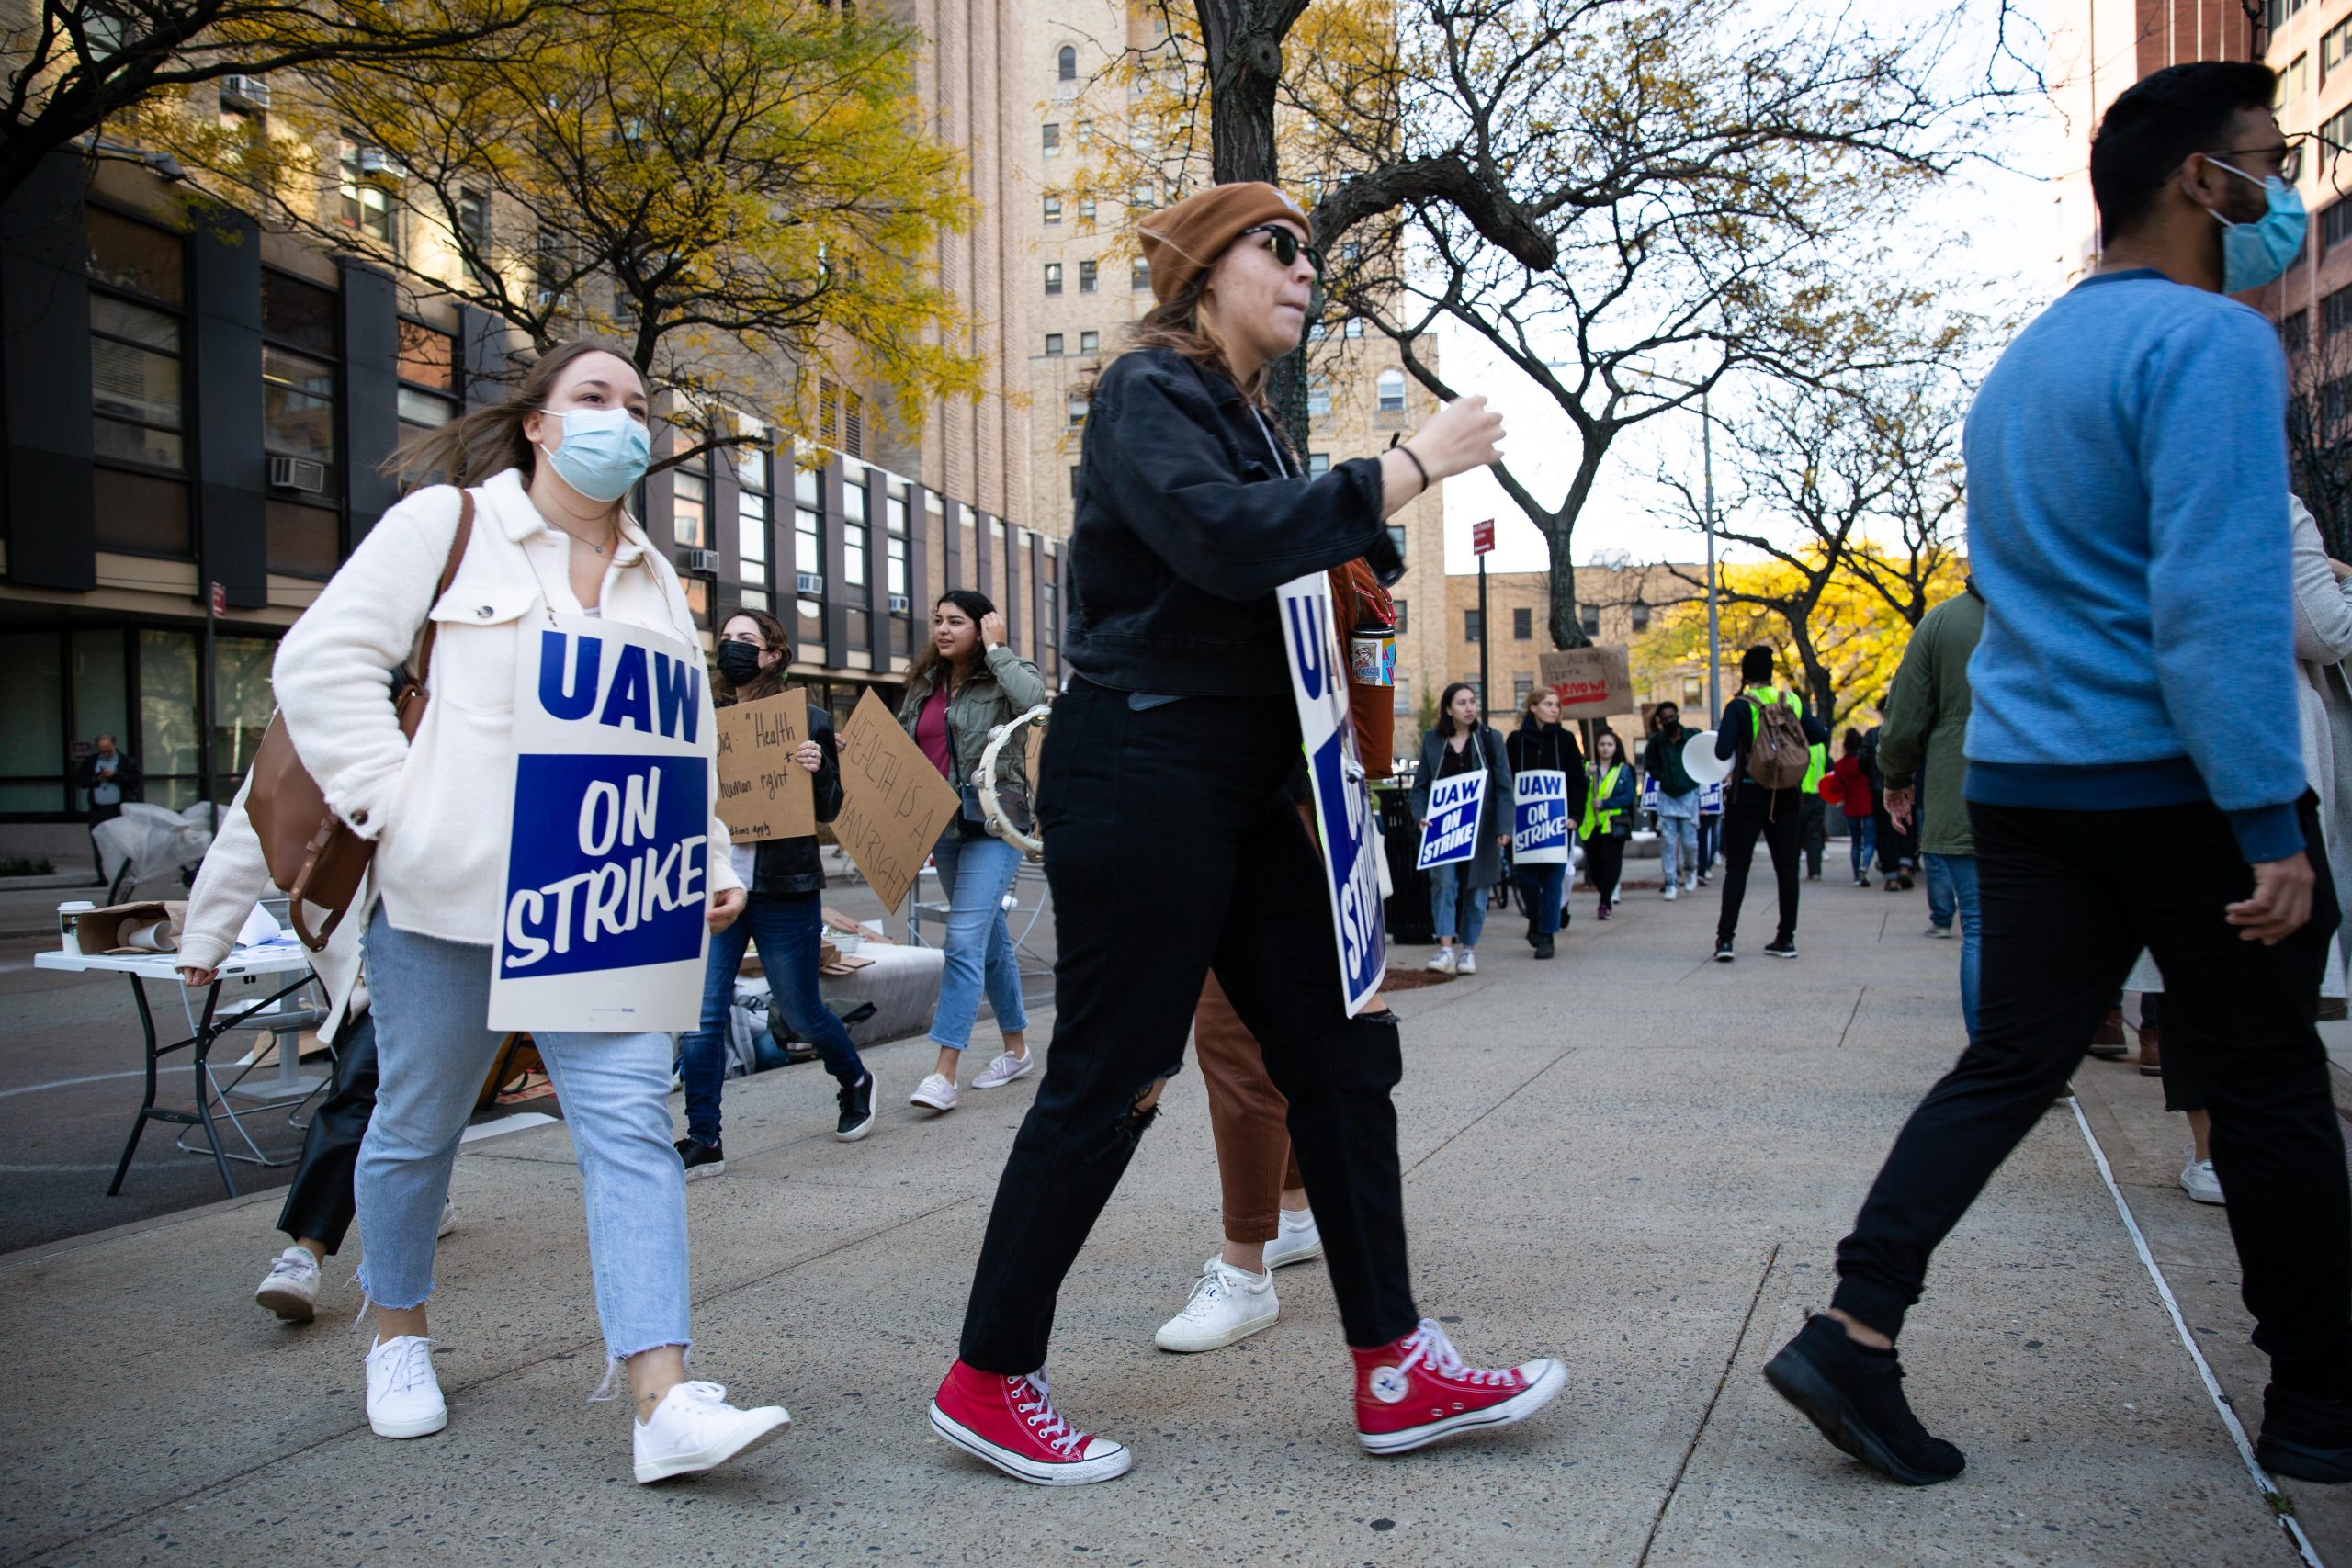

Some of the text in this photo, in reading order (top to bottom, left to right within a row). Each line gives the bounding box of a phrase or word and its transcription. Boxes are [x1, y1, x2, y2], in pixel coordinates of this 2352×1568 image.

[538, 629, 701, 745] UAW
[847, 708, 902, 802] HEALTH
[578, 766, 661, 856] ON
[1432, 779, 1481, 808] UAW
[1519, 775, 1561, 796] UAW
[1527, 801, 1549, 824] ON
[895, 778, 934, 852] IS A
[1423, 822, 1474, 863] STRIKE
[1441, 808, 1462, 835] ON
[1515, 816, 1566, 852] STRIKE
[864, 829, 910, 905] RIGHT
[505, 834, 707, 969] STRIKE
